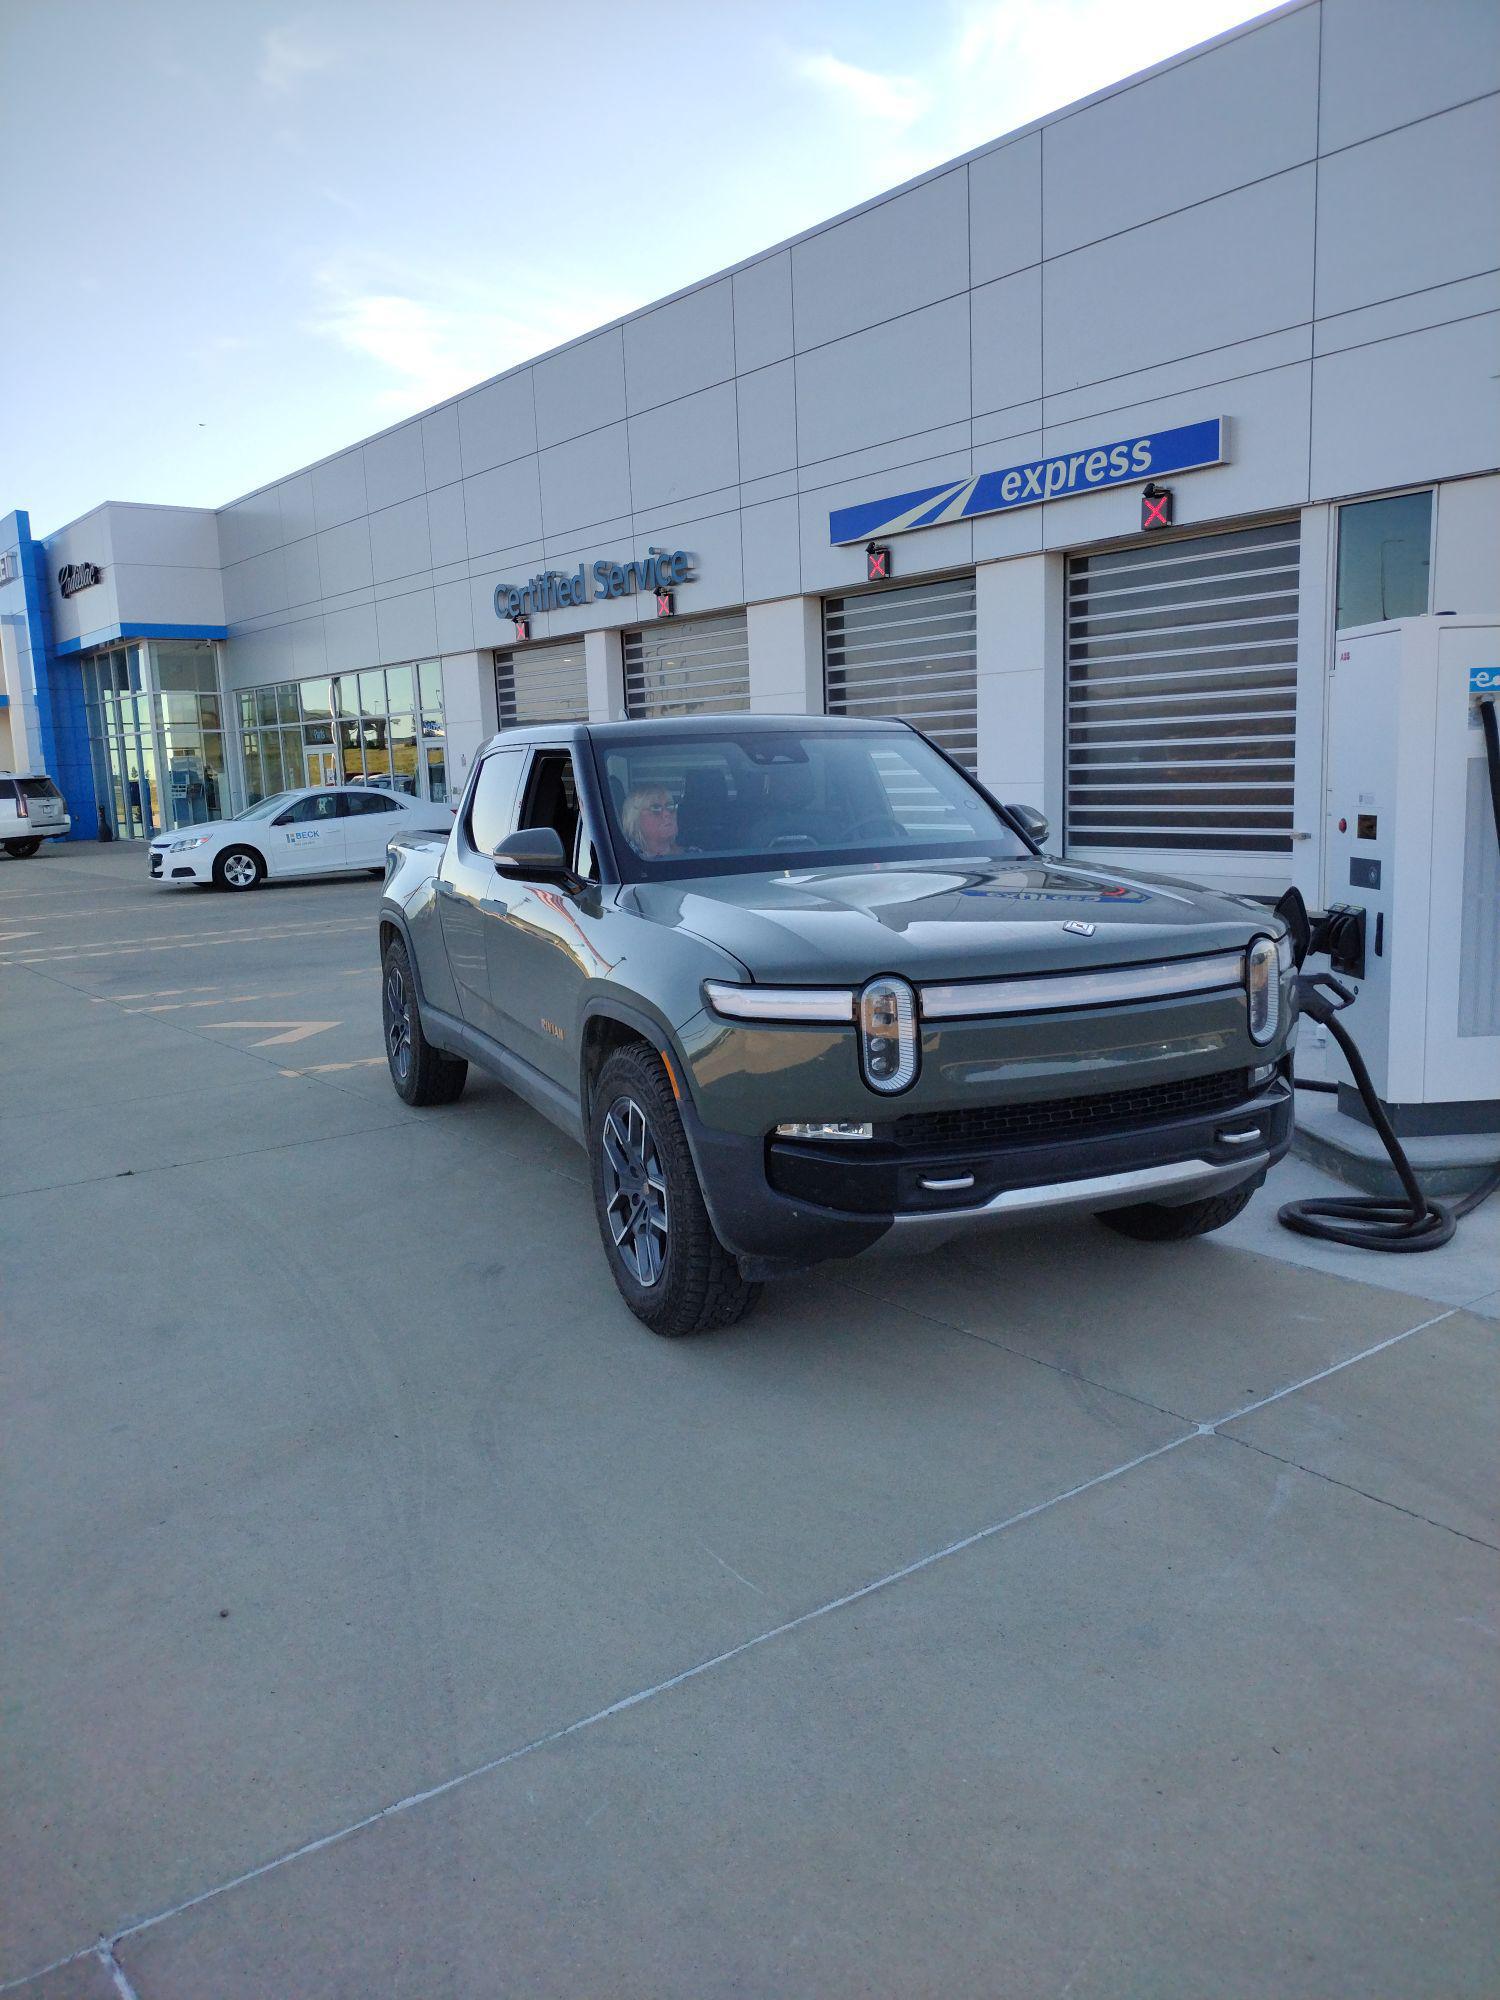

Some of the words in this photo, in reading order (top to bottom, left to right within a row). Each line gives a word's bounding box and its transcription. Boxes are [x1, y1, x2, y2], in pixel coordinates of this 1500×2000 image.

[1001, 439, 1152, 501] express
[59, 562, 96, 599] Cadillac
[494, 563, 586, 619] Certified
[593, 546, 695, 599] Service
[295, 830, 320, 840] BECK
